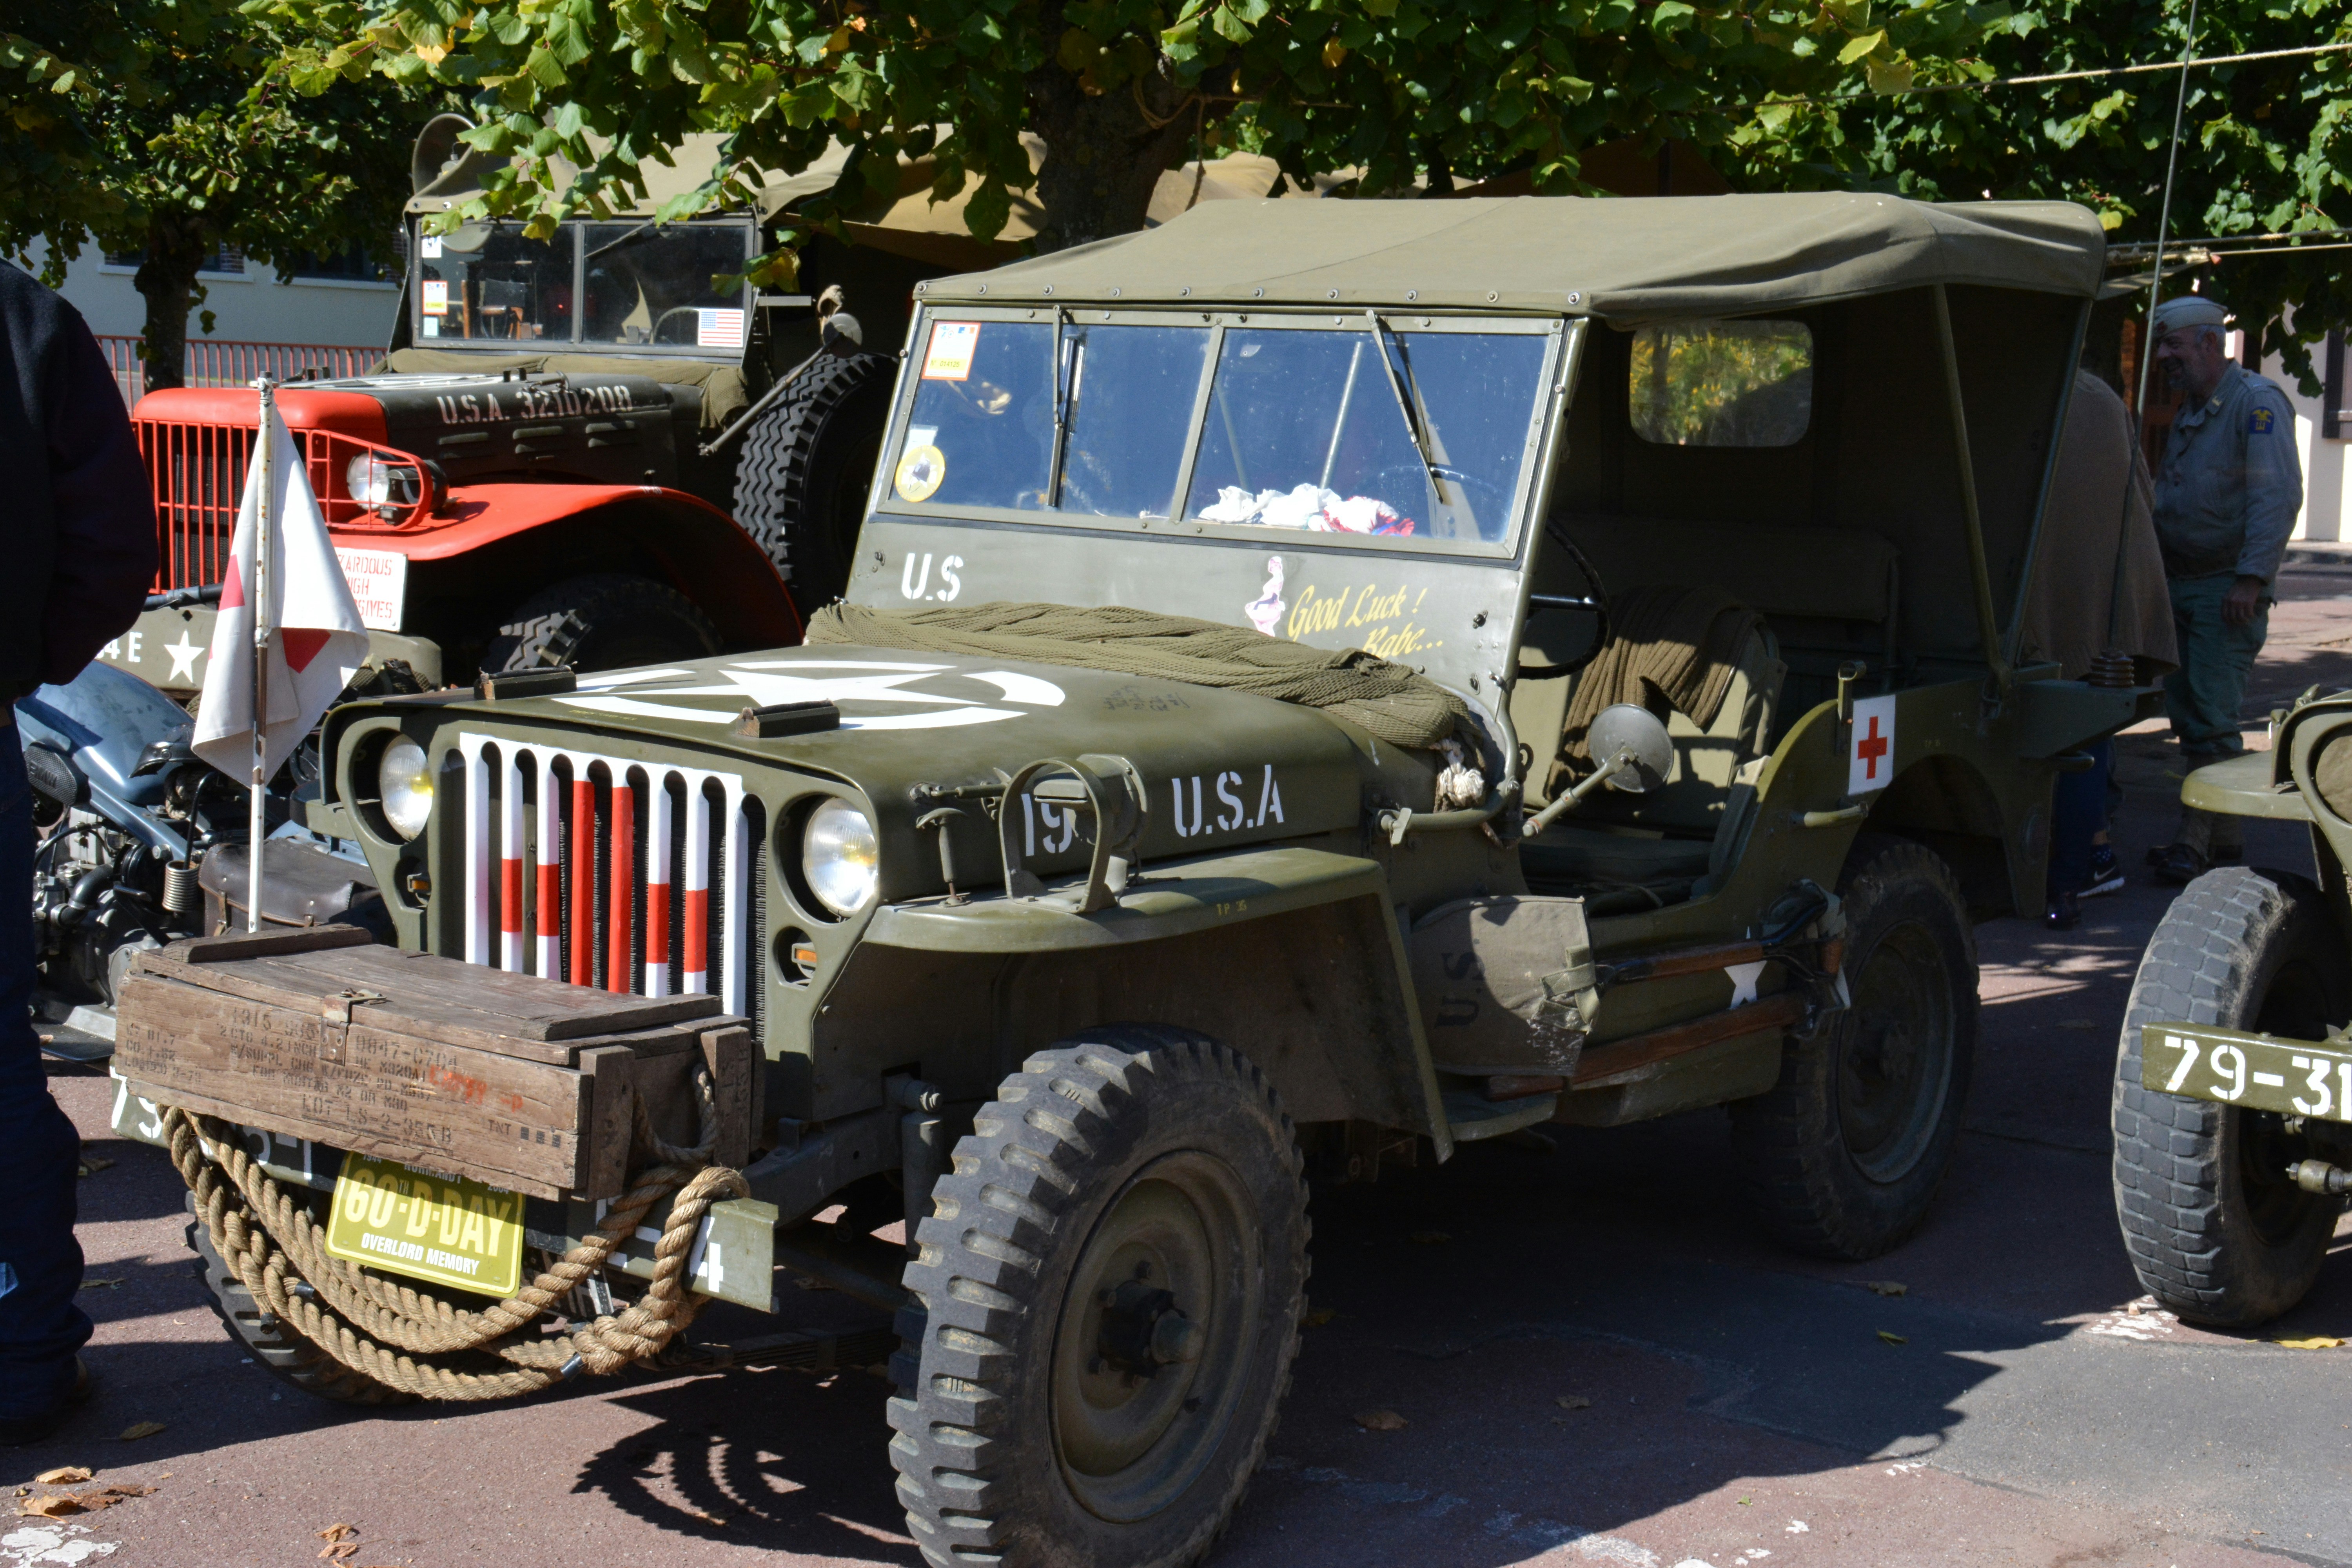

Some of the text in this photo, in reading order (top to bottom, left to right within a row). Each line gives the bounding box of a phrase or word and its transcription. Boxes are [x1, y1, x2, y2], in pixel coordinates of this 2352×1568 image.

[515, 385, 632, 419] 3210208
[1289, 585, 1350, 642] Good
[1345, 584, 1407, 627] Luck
[128, 632, 143, 662] E
[29, 759, 58, 789] BMW
[488, 1119, 511, 1136] TNT
[361, 1232, 480, 1276] OVERLORD MEMORY
